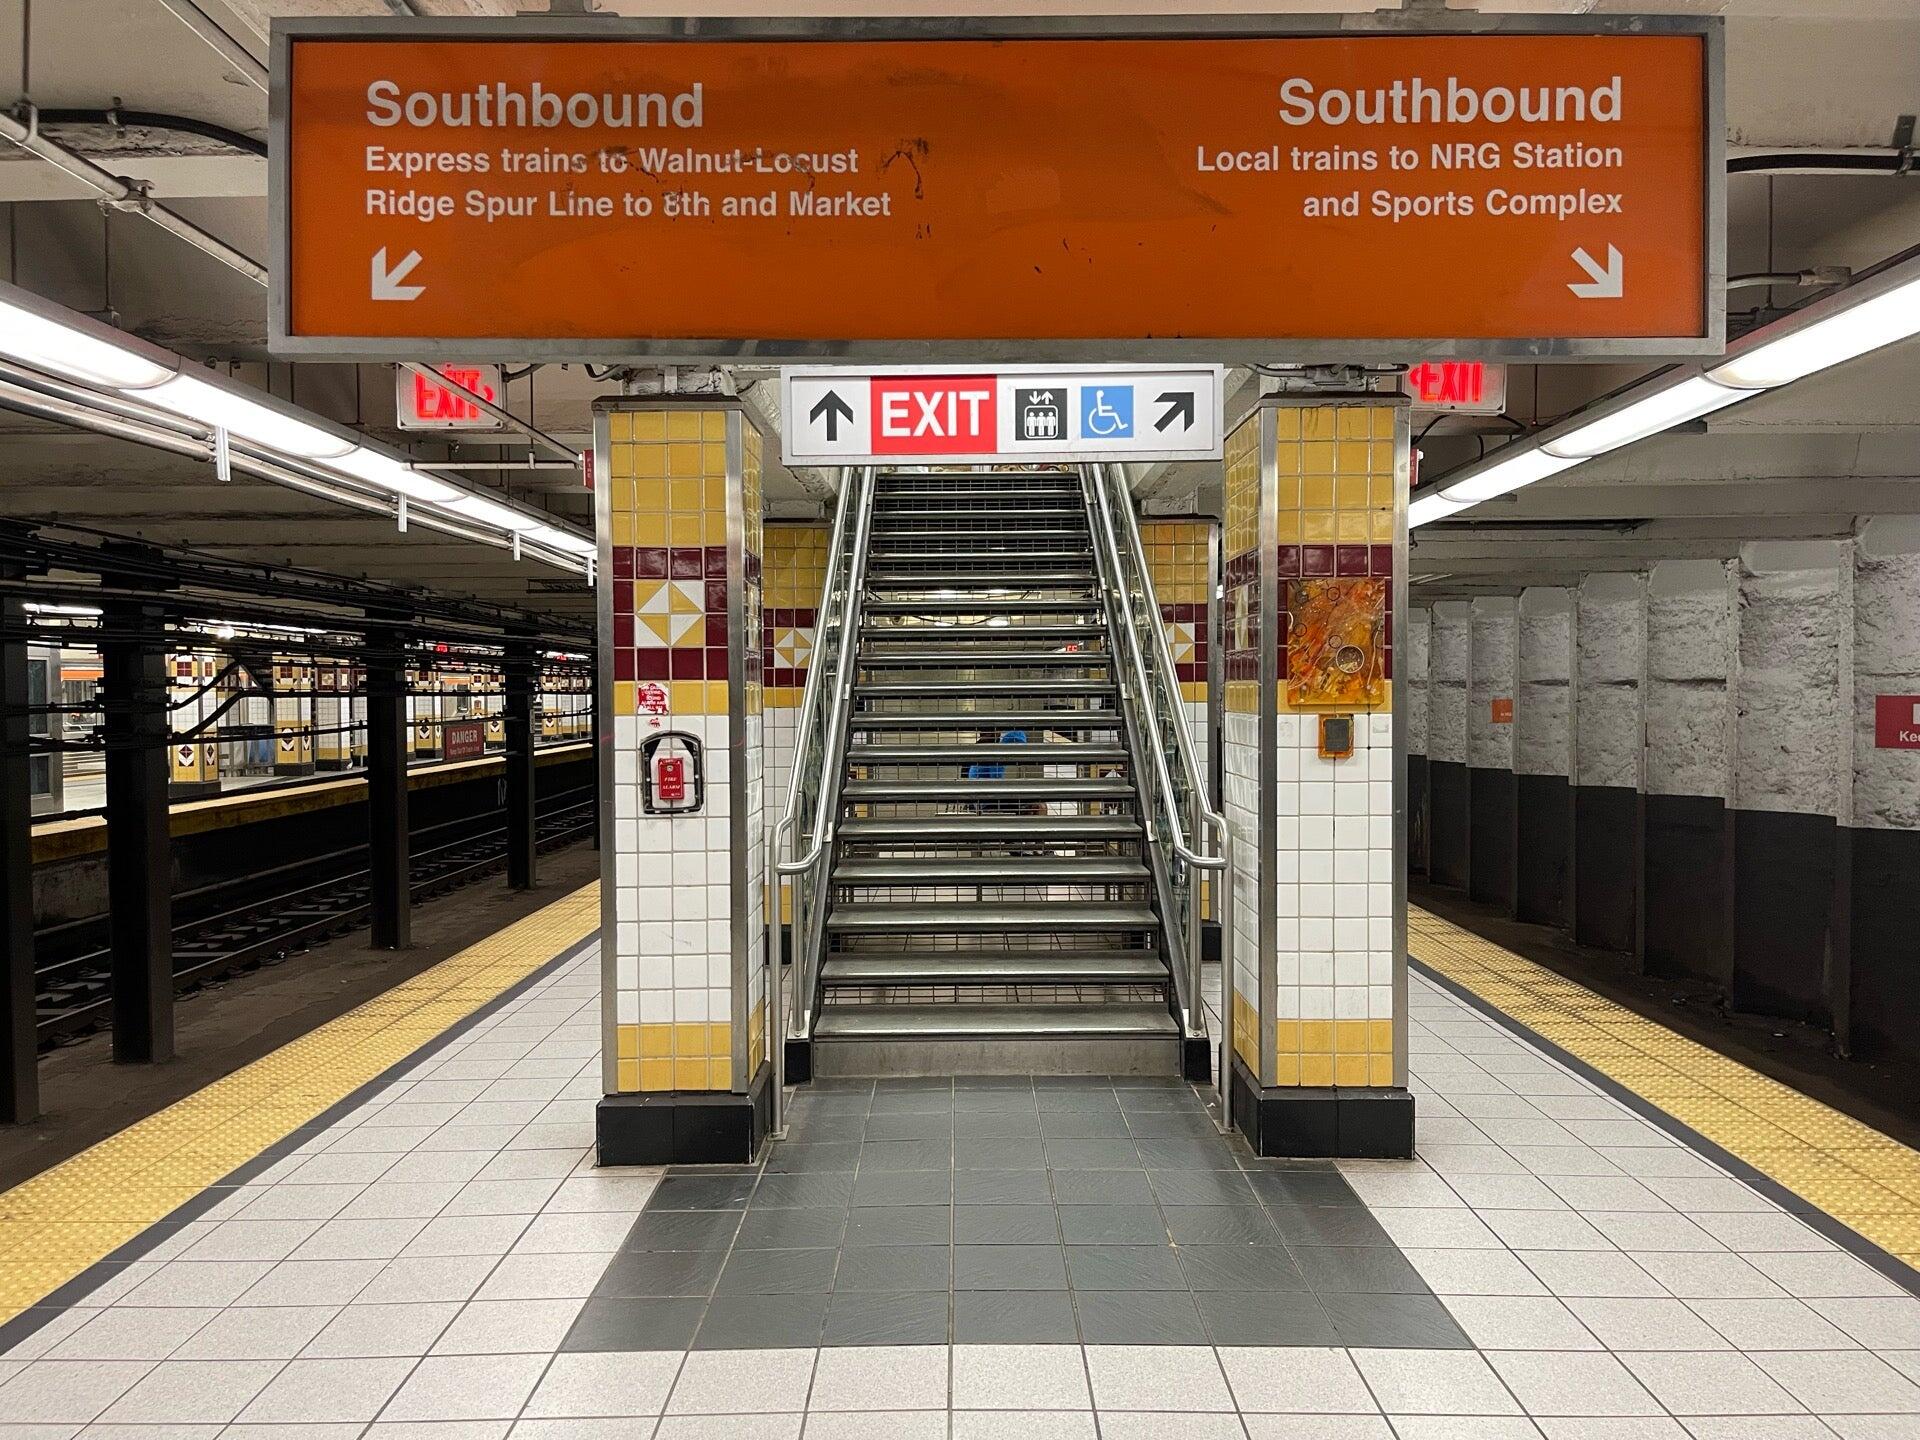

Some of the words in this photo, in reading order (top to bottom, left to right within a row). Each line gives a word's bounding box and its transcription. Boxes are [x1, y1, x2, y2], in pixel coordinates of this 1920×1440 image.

[367, 81, 702, 128] Southbound
[1279, 76, 1622, 126] Southbound
[366, 146, 490, 178] Express
[501, 147, 587, 173] trains
[599, 151, 628, 173] to
[638, 147, 858, 173] Walnut-Locust
[1197, 145, 1279, 172] Local
[1290, 145, 1378, 171] trains
[1388, 145, 1419, 170] to
[1431, 142, 1500, 169] NRG
[1513, 141, 1623, 169] Station
[366, 189, 455, 222] Ridge
[465, 190, 538, 223] Spur
[549, 191, 613, 217] Line
[623, 192, 652, 217] to
[663, 191, 710, 217] 8th
[722, 191, 777, 217] and
[790, 191, 891, 217] Market
[1303, 191, 1359, 217] and
[1371, 190, 1474, 223] Sports
[1486, 188, 1623, 221] Complex
[881, 390, 990, 437] EXIT
[451, 730, 478, 745] DANGER
[1899, 730, 1920, 742] Ke
